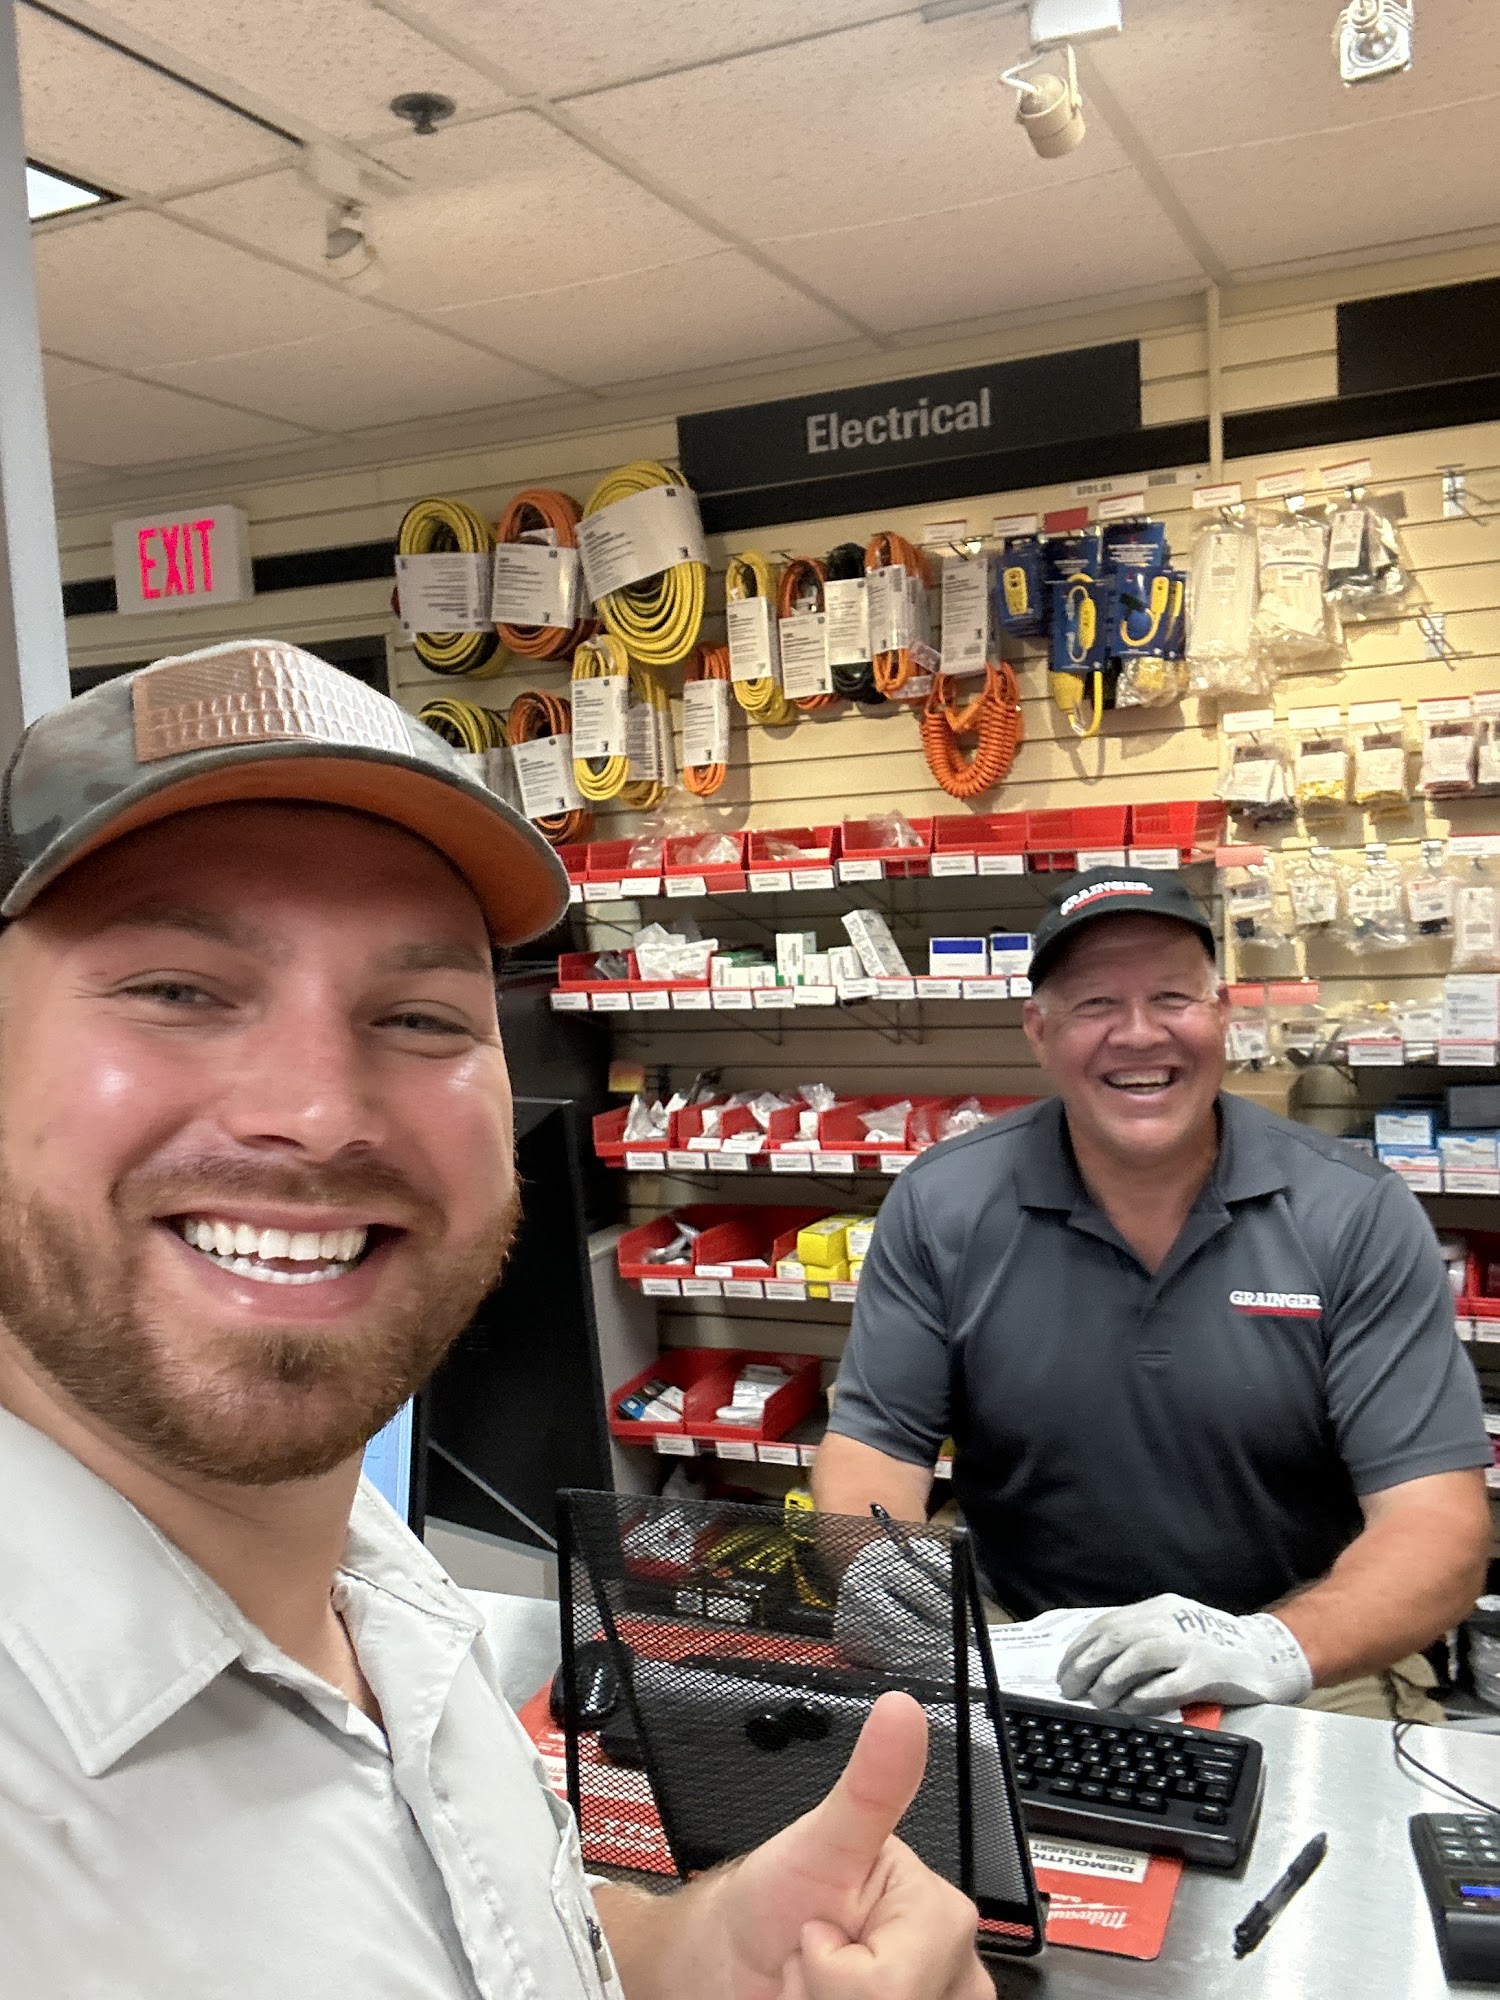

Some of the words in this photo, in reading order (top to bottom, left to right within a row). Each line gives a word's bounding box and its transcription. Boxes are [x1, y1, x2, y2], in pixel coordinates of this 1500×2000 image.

[806, 387, 992, 454] Electrical
[137, 518, 215, 600] EXIT
[1229, 1290, 1323, 1309] GRAINGER
[1030, 1851, 1135, 1874] DEMOLITIO
[1047, 1910, 1129, 1929] Milwau
